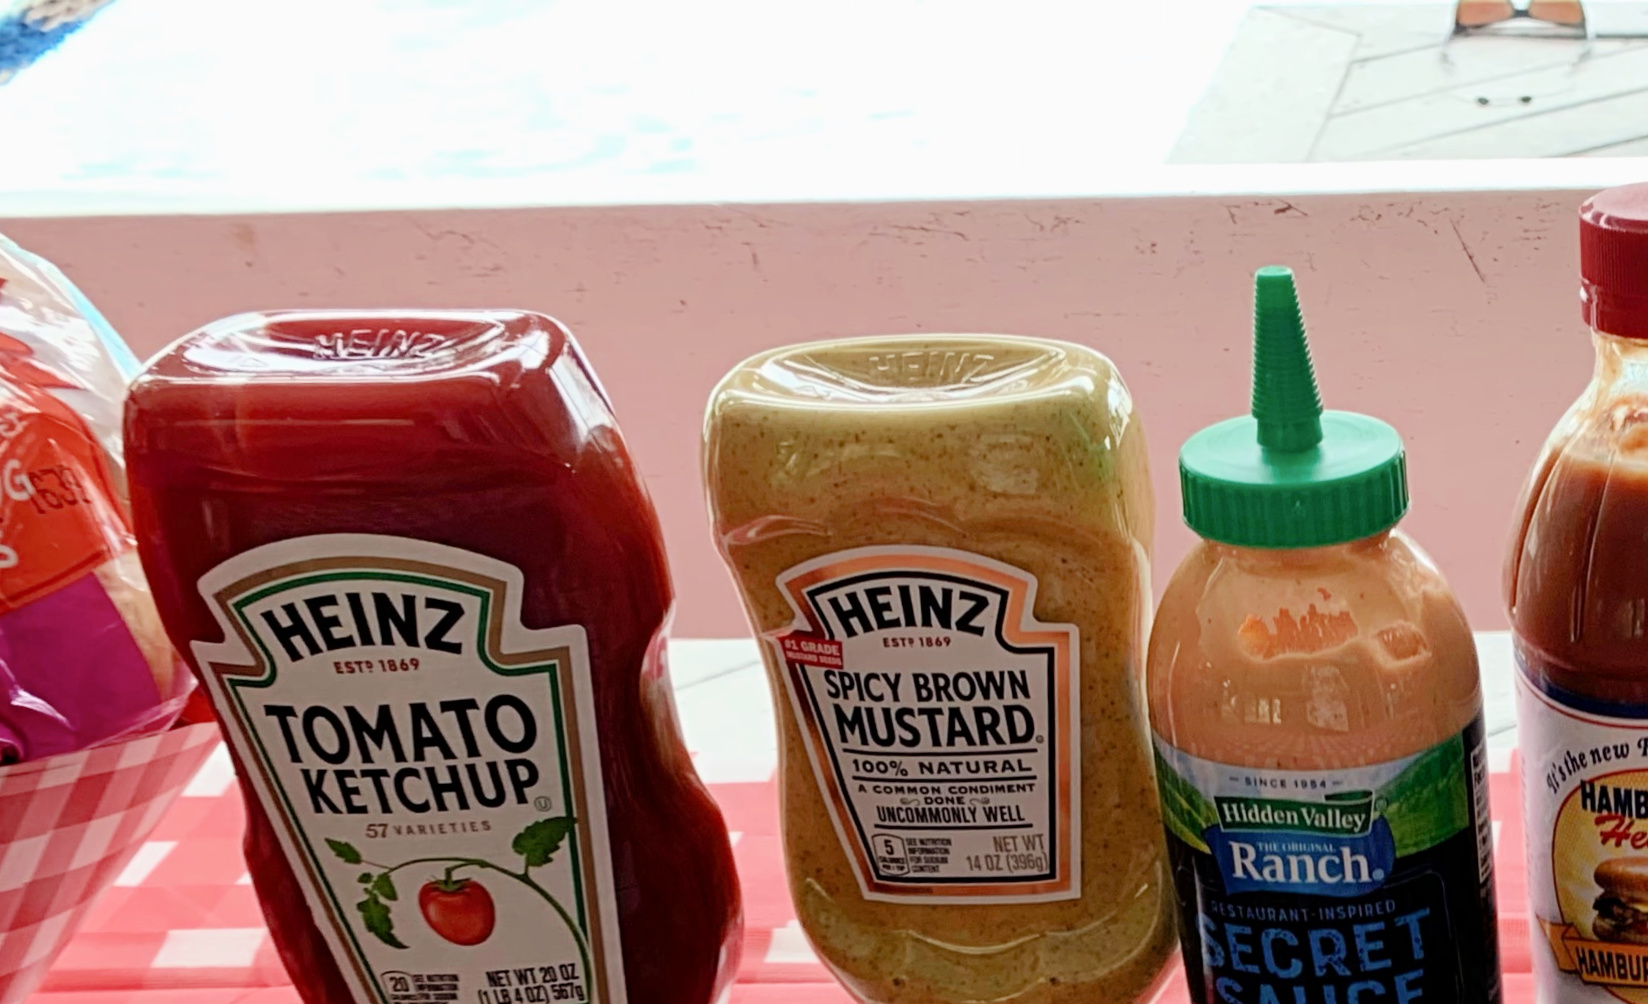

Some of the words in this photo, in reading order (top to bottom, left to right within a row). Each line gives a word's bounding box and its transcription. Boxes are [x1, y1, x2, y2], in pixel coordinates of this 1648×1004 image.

[827, 585, 990, 637] HEINZ
[259, 592, 466, 663] HEINZ
[800, 641, 841, 656] GRADE
[919, 636, 952, 648] 1869
[379, 657, 420, 673] 1869
[824, 669, 902, 702] SPICY
[912, 669, 1031, 702] BROWN
[263, 694, 538, 766] TOMATO
[833, 703, 1036, 748] MUSTARD
[852, 758, 908, 777] 100%
[919, 759, 1032, 775] NATURAL
[1545, 764, 1567, 795] It's
[1563, 750, 1588, 778] the
[1590, 738, 1631, 764] new
[299, 758, 540, 815] KETCHUP
[858, 784, 868, 794] A
[872, 784, 941, 795] COMMON
[948, 783, 1036, 795] CONDIMENT
[1244, 776, 1287, 788] SINCE
[924, 797, 966, 806] DONE
[876, 806, 978, 824] UNCOMMONLY
[983, 805, 1026, 823] WELL
[1221, 802, 1298, 825] Hidden
[1301, 806, 1366, 832] Valley
[365, 824, 389, 839] 57
[393, 820, 493, 836] VARIETIES
[884, 839, 894, 856] 5
[992, 836, 1018, 853] NET
[1023, 834, 1045, 851] WT
[1284, 841, 1337, 854] ORIGINAL
[967, 855, 982, 872] 14
[986, 854, 1003, 871] OZ
[1006, 853, 1050, 872] (396g)
[1229, 840, 1372, 883] Ranch
[1211, 899, 1396, 923] RESTAURANT-INSPIRED
[1196, 908, 1431, 979] SECRET
[389, 977, 410, 993] 20
[485, 970, 511, 988] NET
[513, 967, 538, 986] WT
[539, 966, 557, 984] 20
[559, 963, 580, 981] OZ
[514, 988, 524, 1004] 4
[526, 985, 550, 1004] OZ)
[551, 982, 585, 1002] 567g
